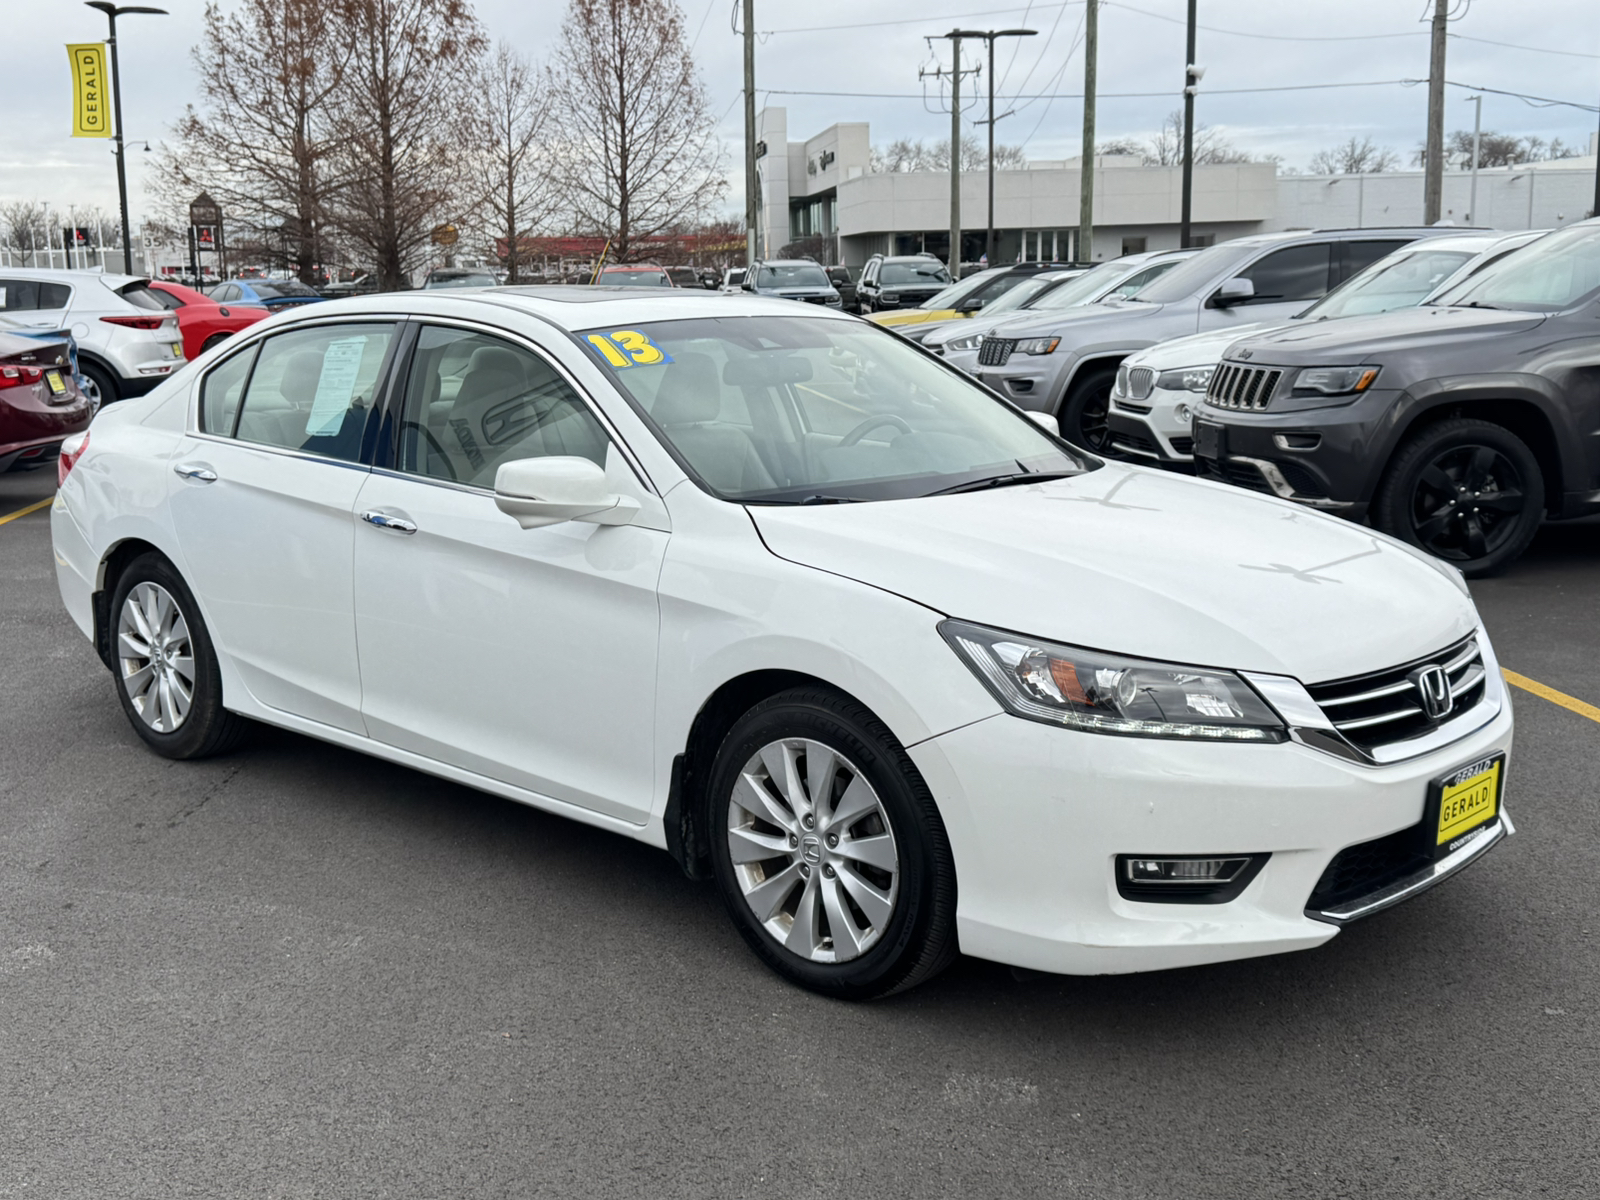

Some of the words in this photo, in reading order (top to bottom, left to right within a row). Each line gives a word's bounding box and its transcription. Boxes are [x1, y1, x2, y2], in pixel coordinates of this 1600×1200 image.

[83, 55, 98, 125] GERALD
[144, 237, 162, 248] 35
[587, 330, 665, 368] 13
[1454, 760, 1492, 784] GERALD
[1443, 786, 1489, 822] GERALD
